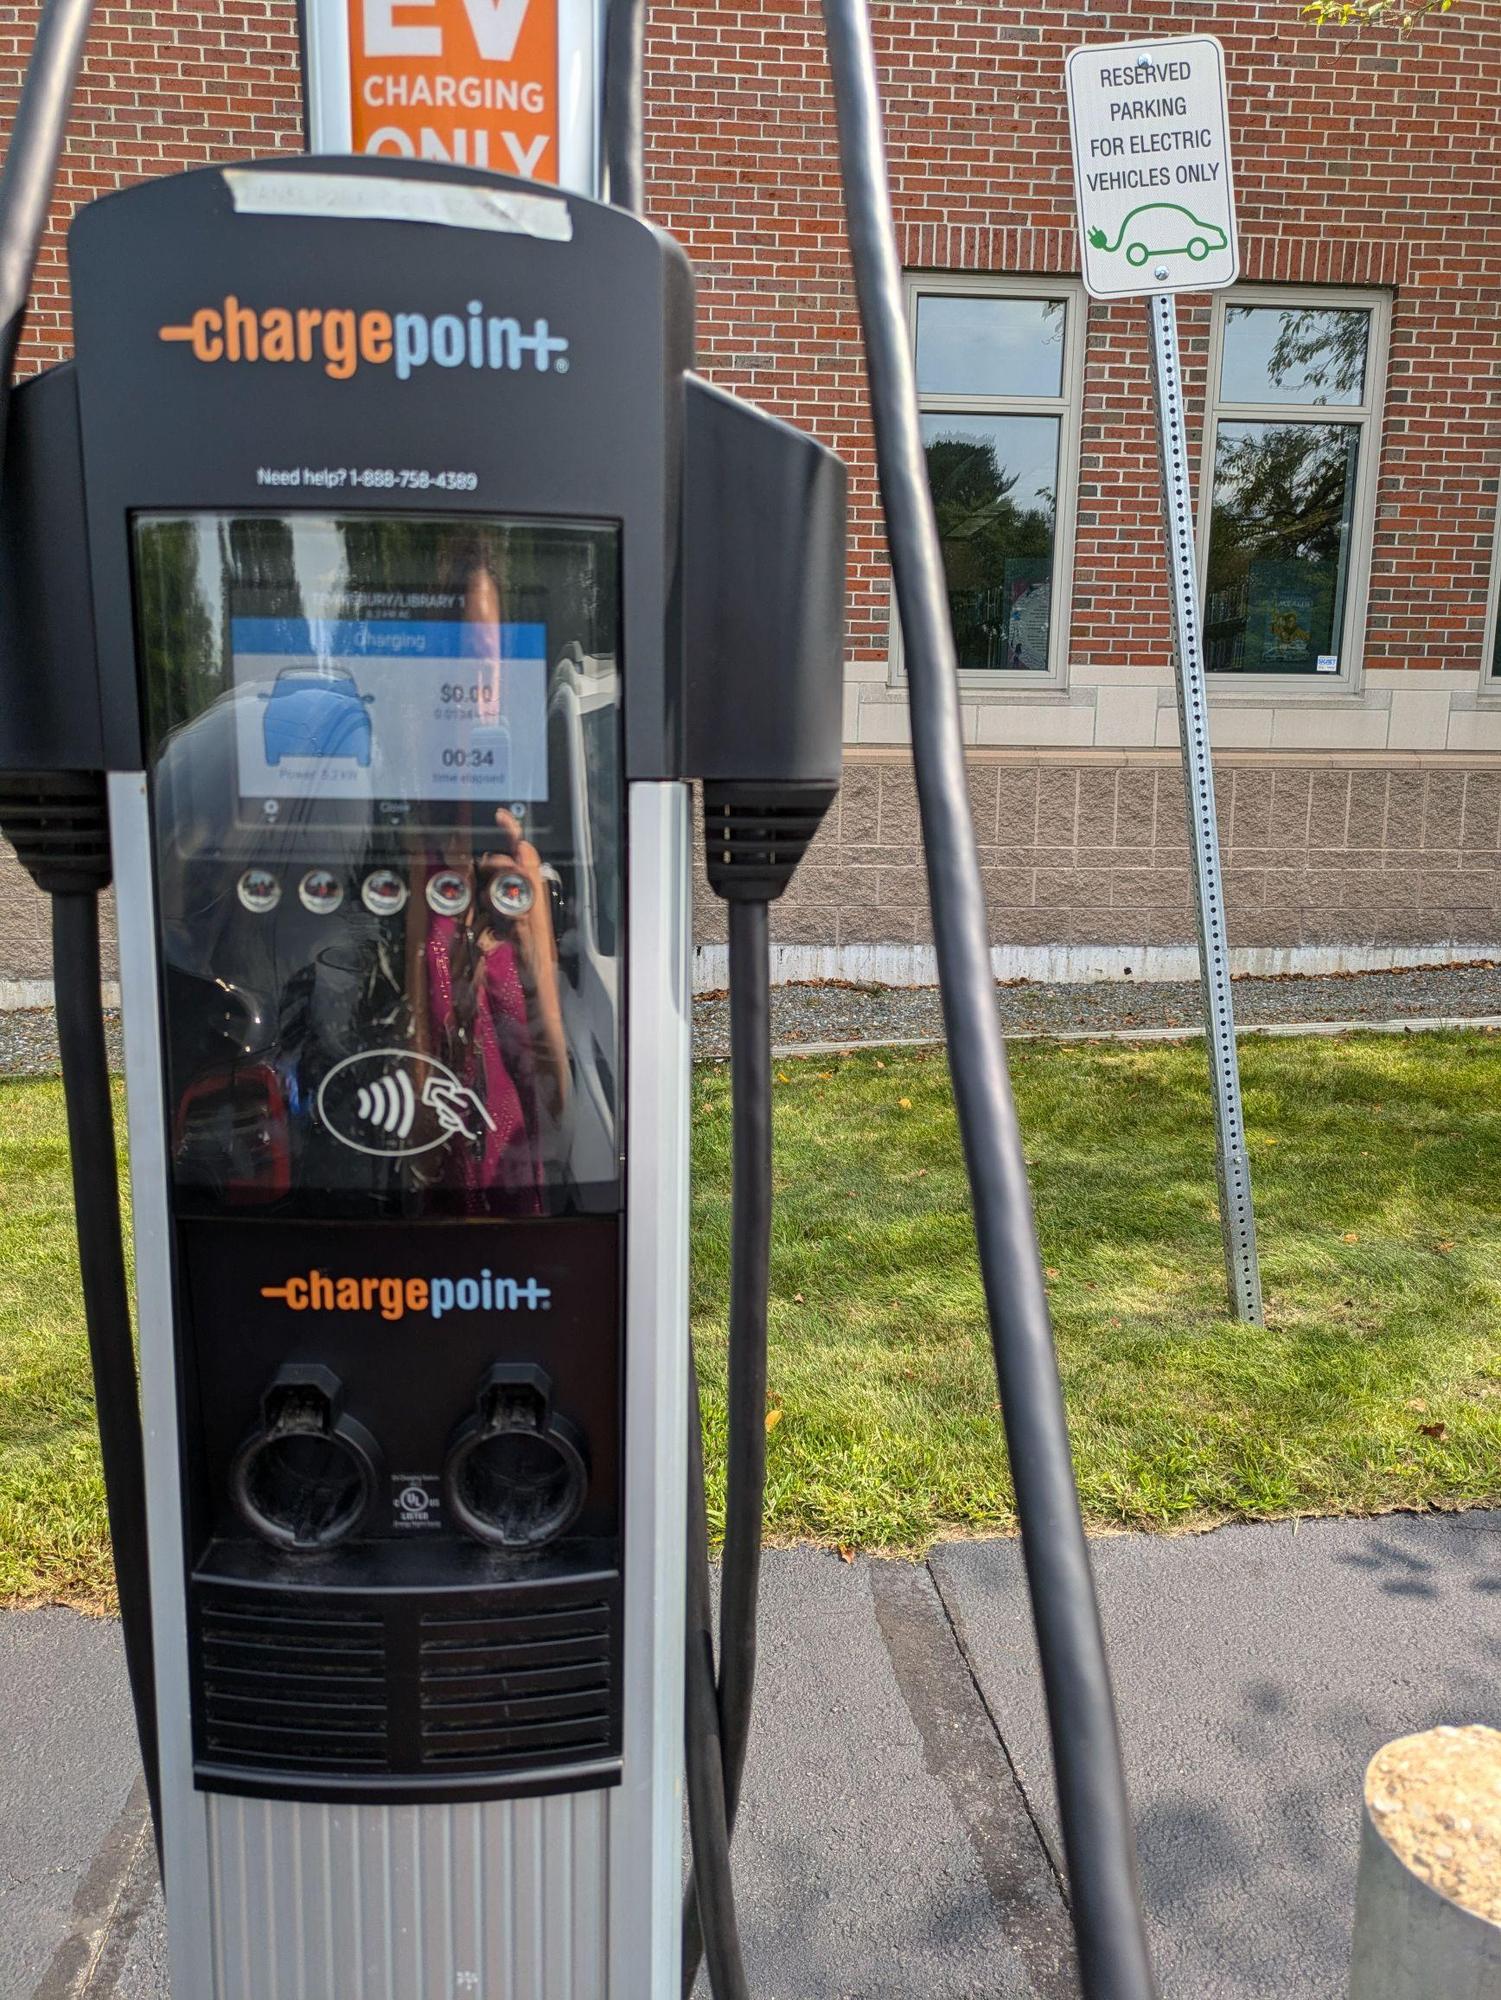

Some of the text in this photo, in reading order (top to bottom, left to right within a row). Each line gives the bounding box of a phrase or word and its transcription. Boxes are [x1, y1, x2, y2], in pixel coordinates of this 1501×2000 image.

[1100, 61, 1192, 88] RESERVED
[363, 74, 545, 114] CHARGING
[1110, 96, 1187, 121] PARKING
[1090, 128, 1212, 157] FOR ELECTRIC
[1086, 162, 1220, 192] VEHICLES ONLY
[257, 467, 478, 491] Need help? 1-888-758-4389
[354, 633, 426, 652] Charging
[441, 682, 493, 704] $0.00
[442, 749, 494, 767] 00:34
